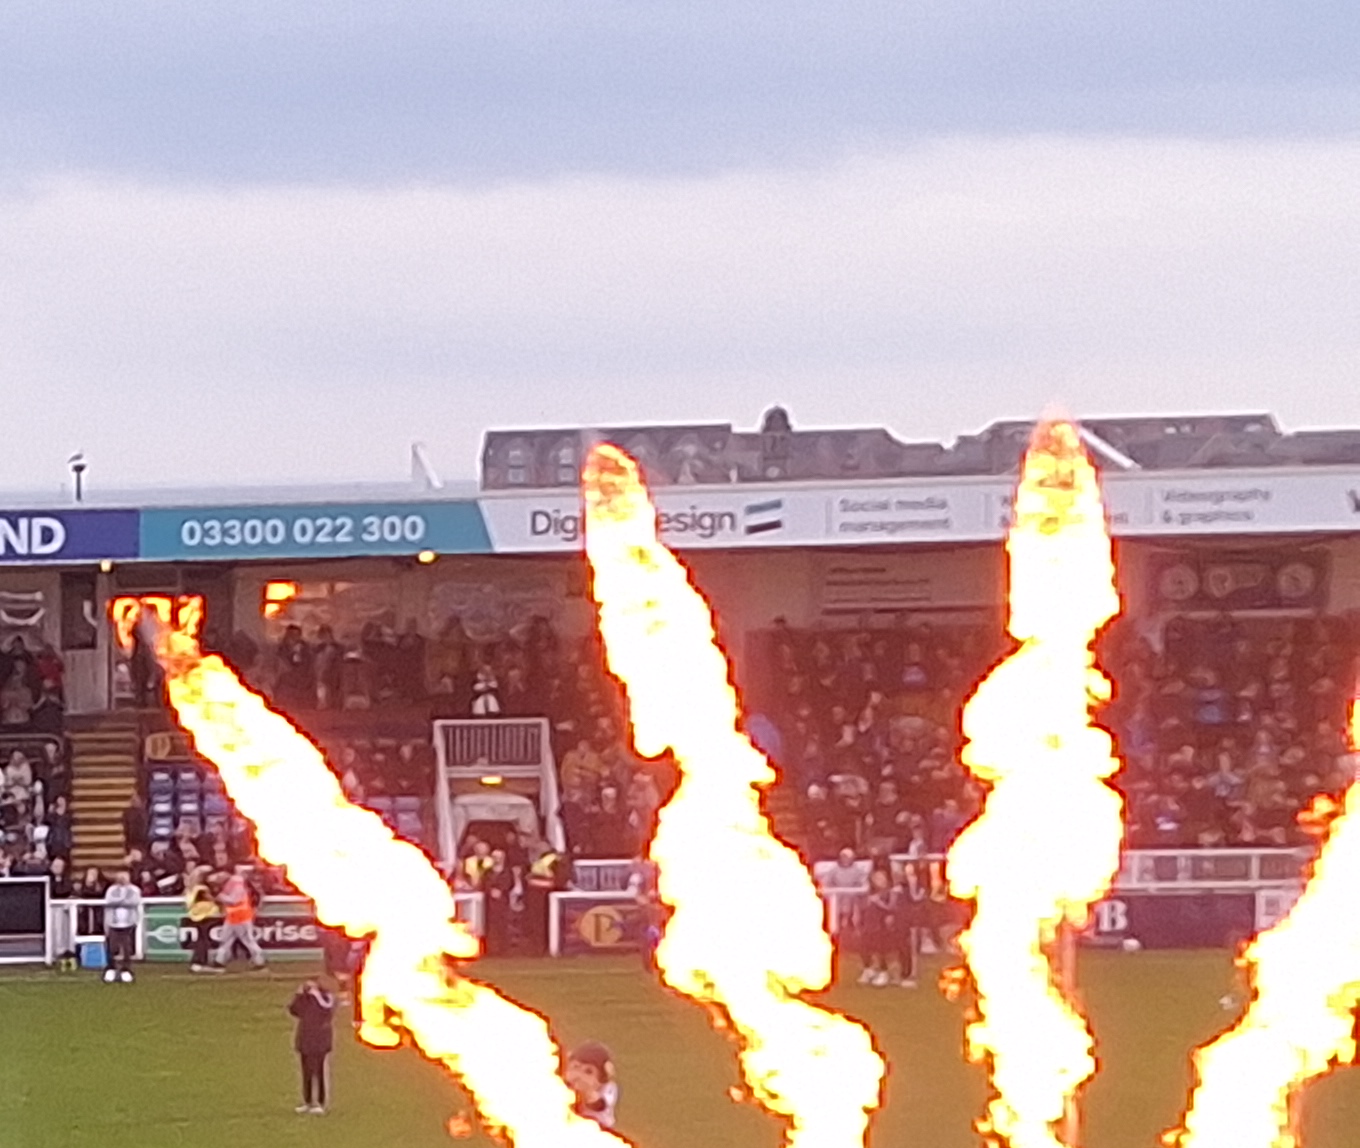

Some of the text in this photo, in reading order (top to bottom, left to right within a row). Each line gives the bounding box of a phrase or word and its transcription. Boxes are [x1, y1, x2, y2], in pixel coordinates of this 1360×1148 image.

[181, 513, 426, 547] 03300 022 300
